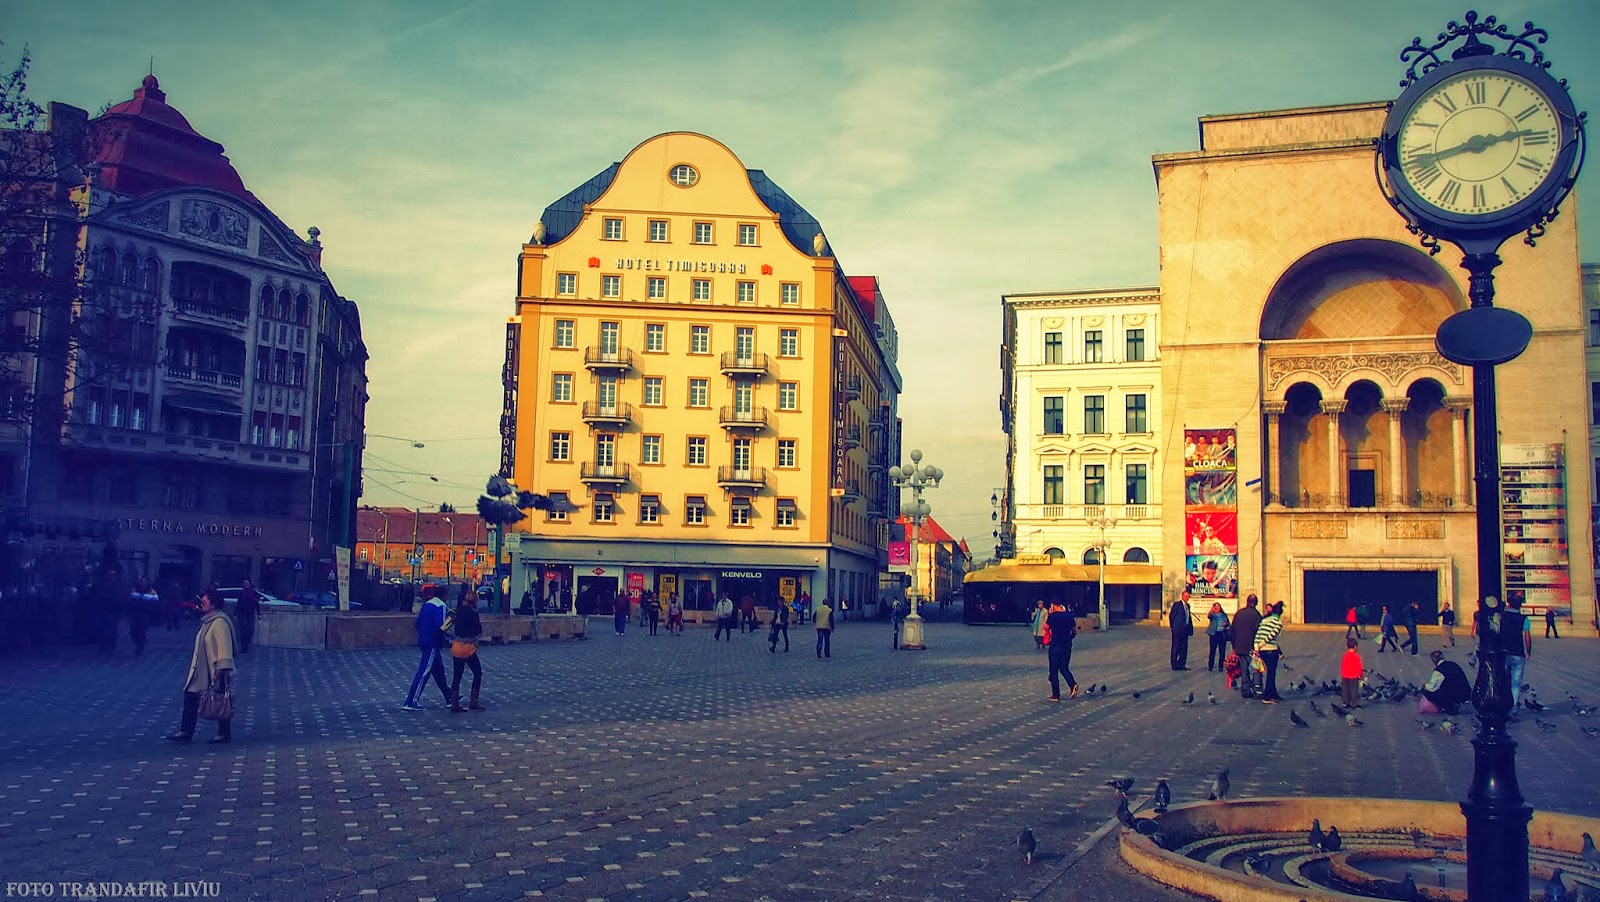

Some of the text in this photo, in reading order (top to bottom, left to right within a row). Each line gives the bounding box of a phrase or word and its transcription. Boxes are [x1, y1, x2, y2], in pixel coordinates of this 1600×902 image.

[616, 258, 661, 270] HOTEL
[506, 329, 514, 380] HOTEL
[1193, 460, 1228, 468] CLOACA
[117, 518, 263, 537] TERNA MODERN
